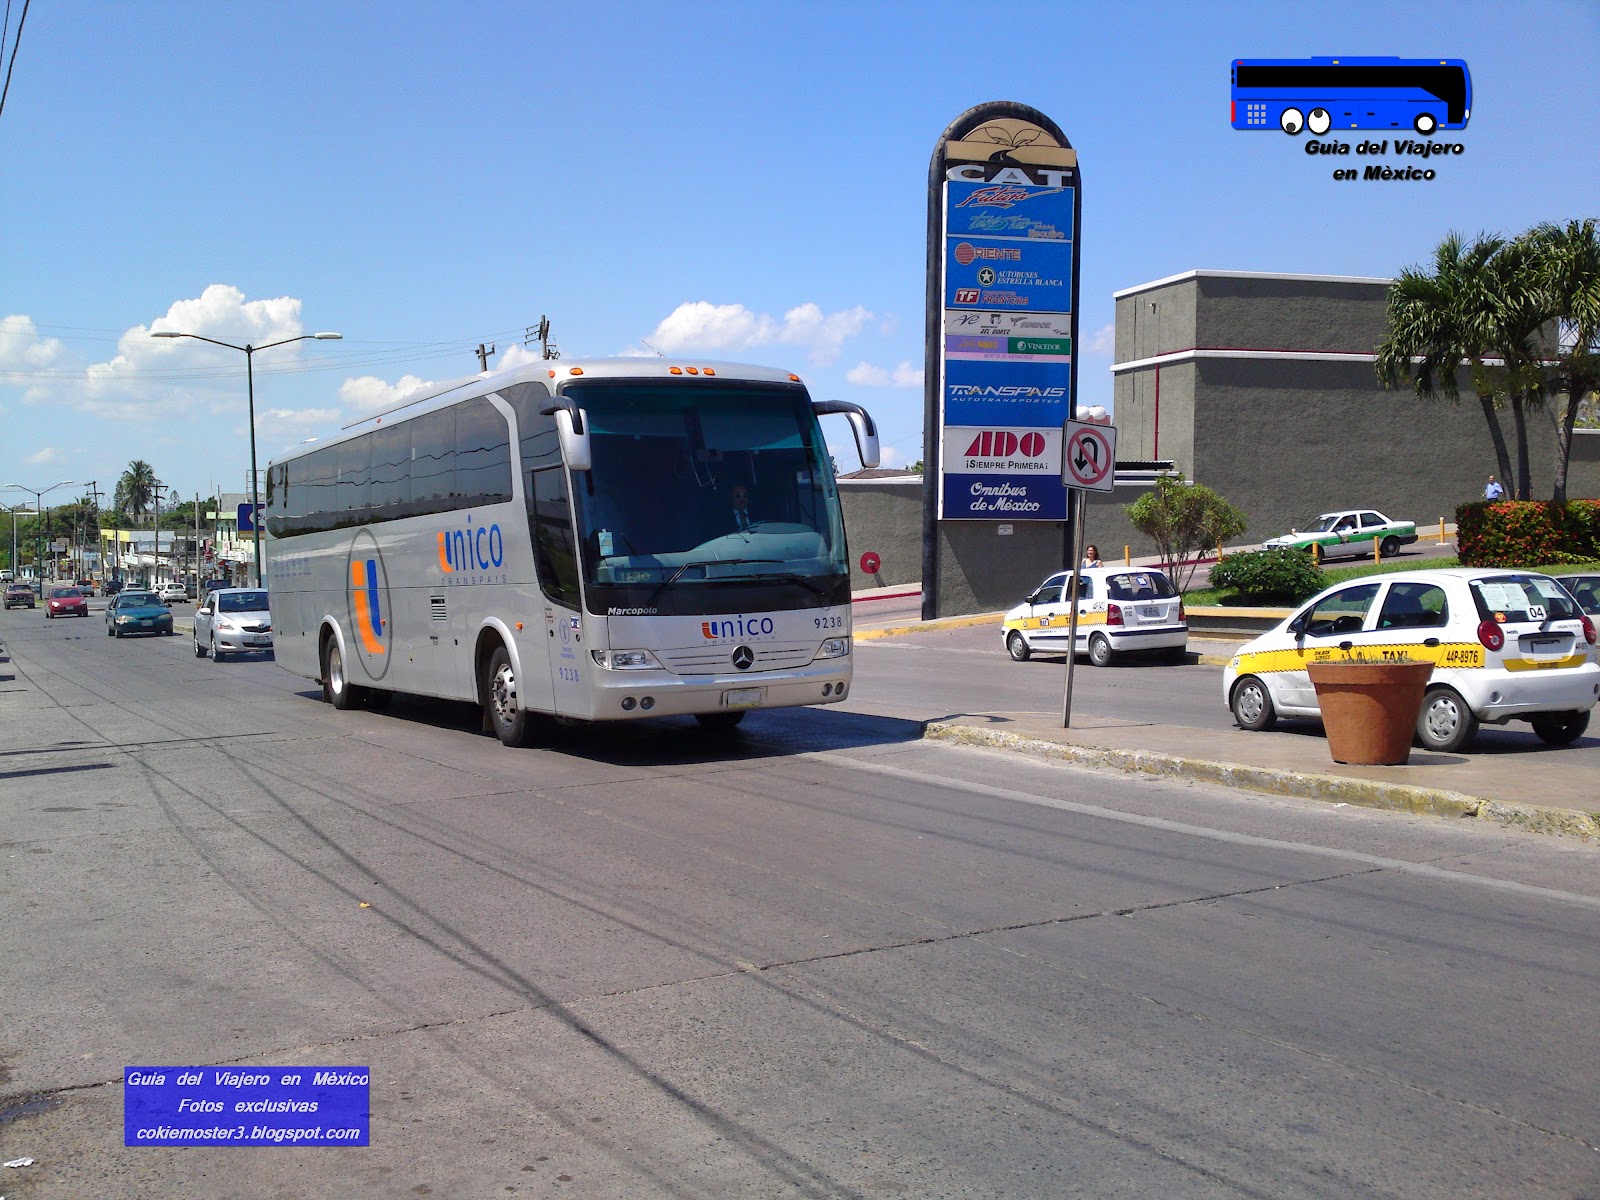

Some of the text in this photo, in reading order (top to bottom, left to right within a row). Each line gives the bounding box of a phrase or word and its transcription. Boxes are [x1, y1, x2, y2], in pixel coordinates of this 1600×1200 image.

[947, 164, 1073, 187] CAT
[997, 271, 1038, 279] AUTOBUSES
[997, 278, 1063, 287] ESTRELLA BLANCA
[957, 290, 978, 302] TF
[1028, 342, 1061, 350] VENCEDOR
[964, 431, 1045, 457] ADO
[970, 482, 1027, 497] Omnibus
[970, 496, 1041, 512] de México
[608, 606, 658, 615] Marcopolo
[1529, 606, 1545, 619] 04
[814, 616, 842, 629] 9238
[1446, 650, 1478, 663] 44P-8976
[559, 667, 579, 682] 9238
